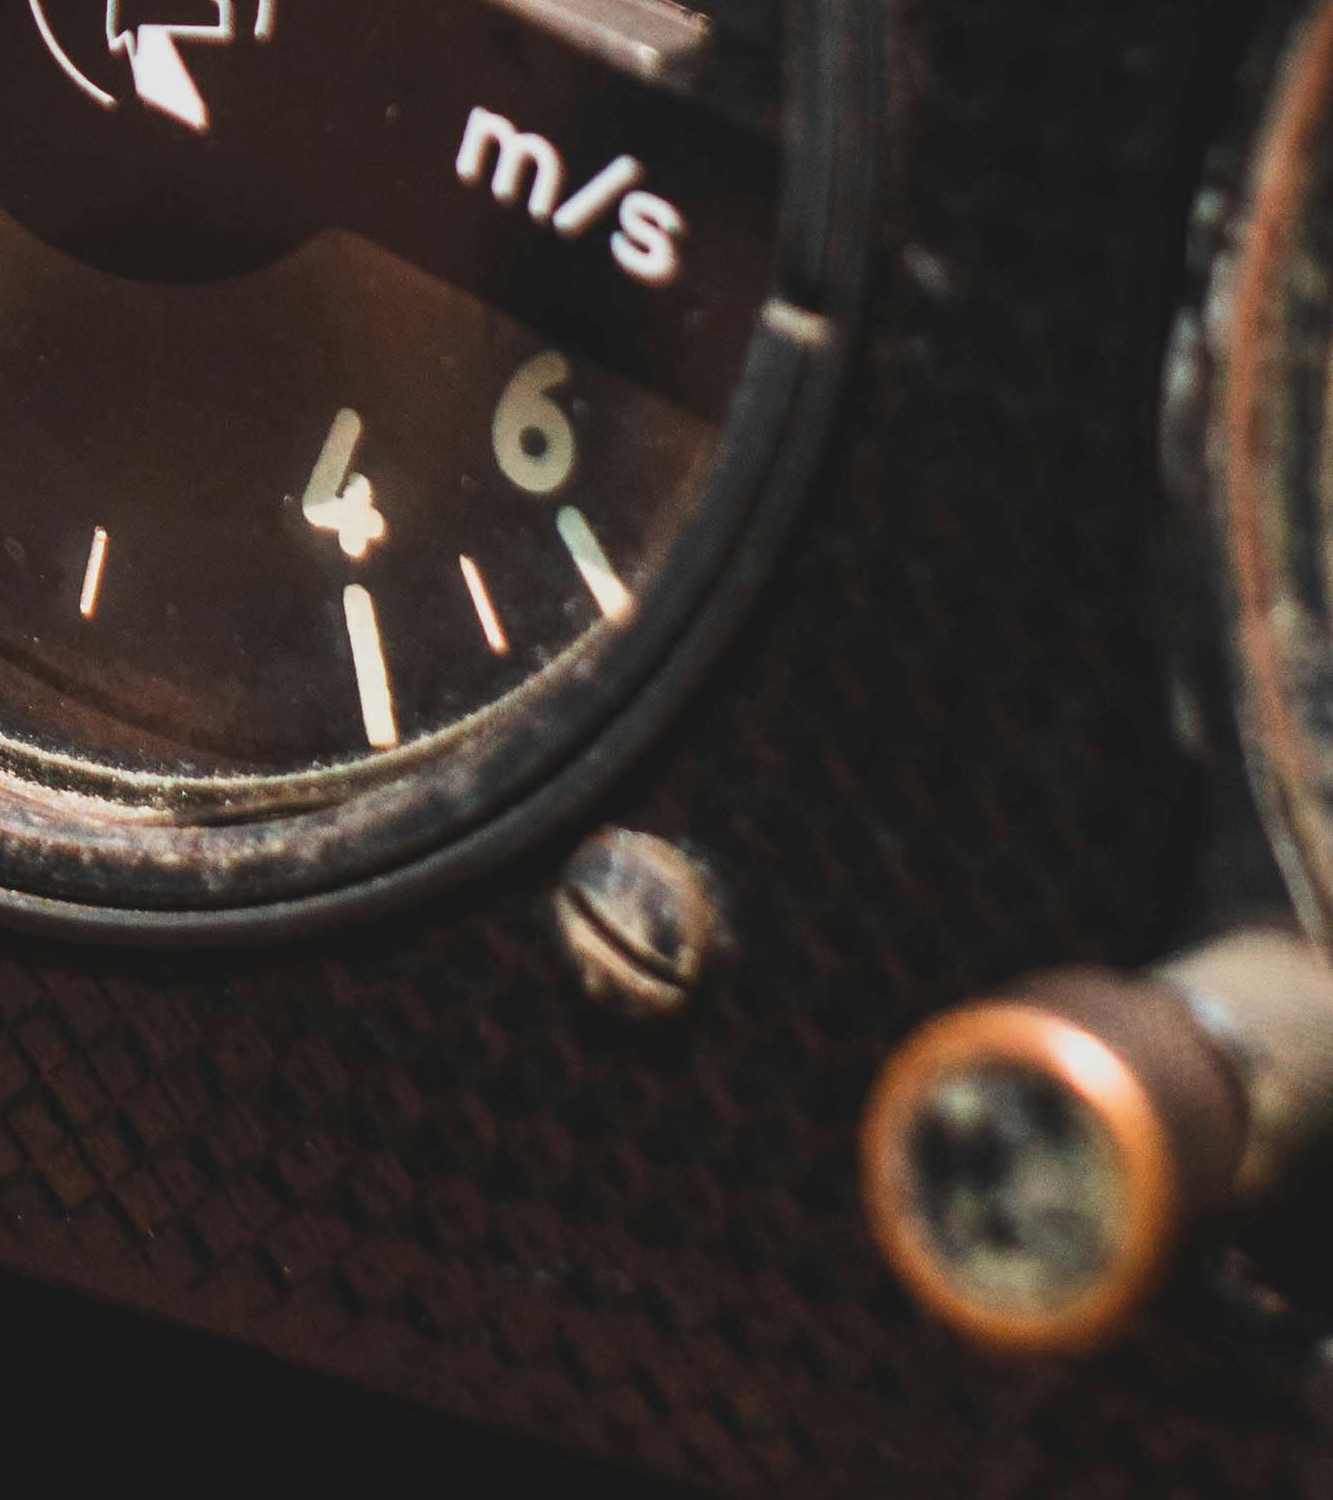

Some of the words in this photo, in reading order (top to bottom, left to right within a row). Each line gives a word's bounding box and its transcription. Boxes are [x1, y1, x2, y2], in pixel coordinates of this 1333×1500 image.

[454, 104, 689, 286] m/s
[303, 407, 386, 559] 4
[491, 352, 575, 493] 6
